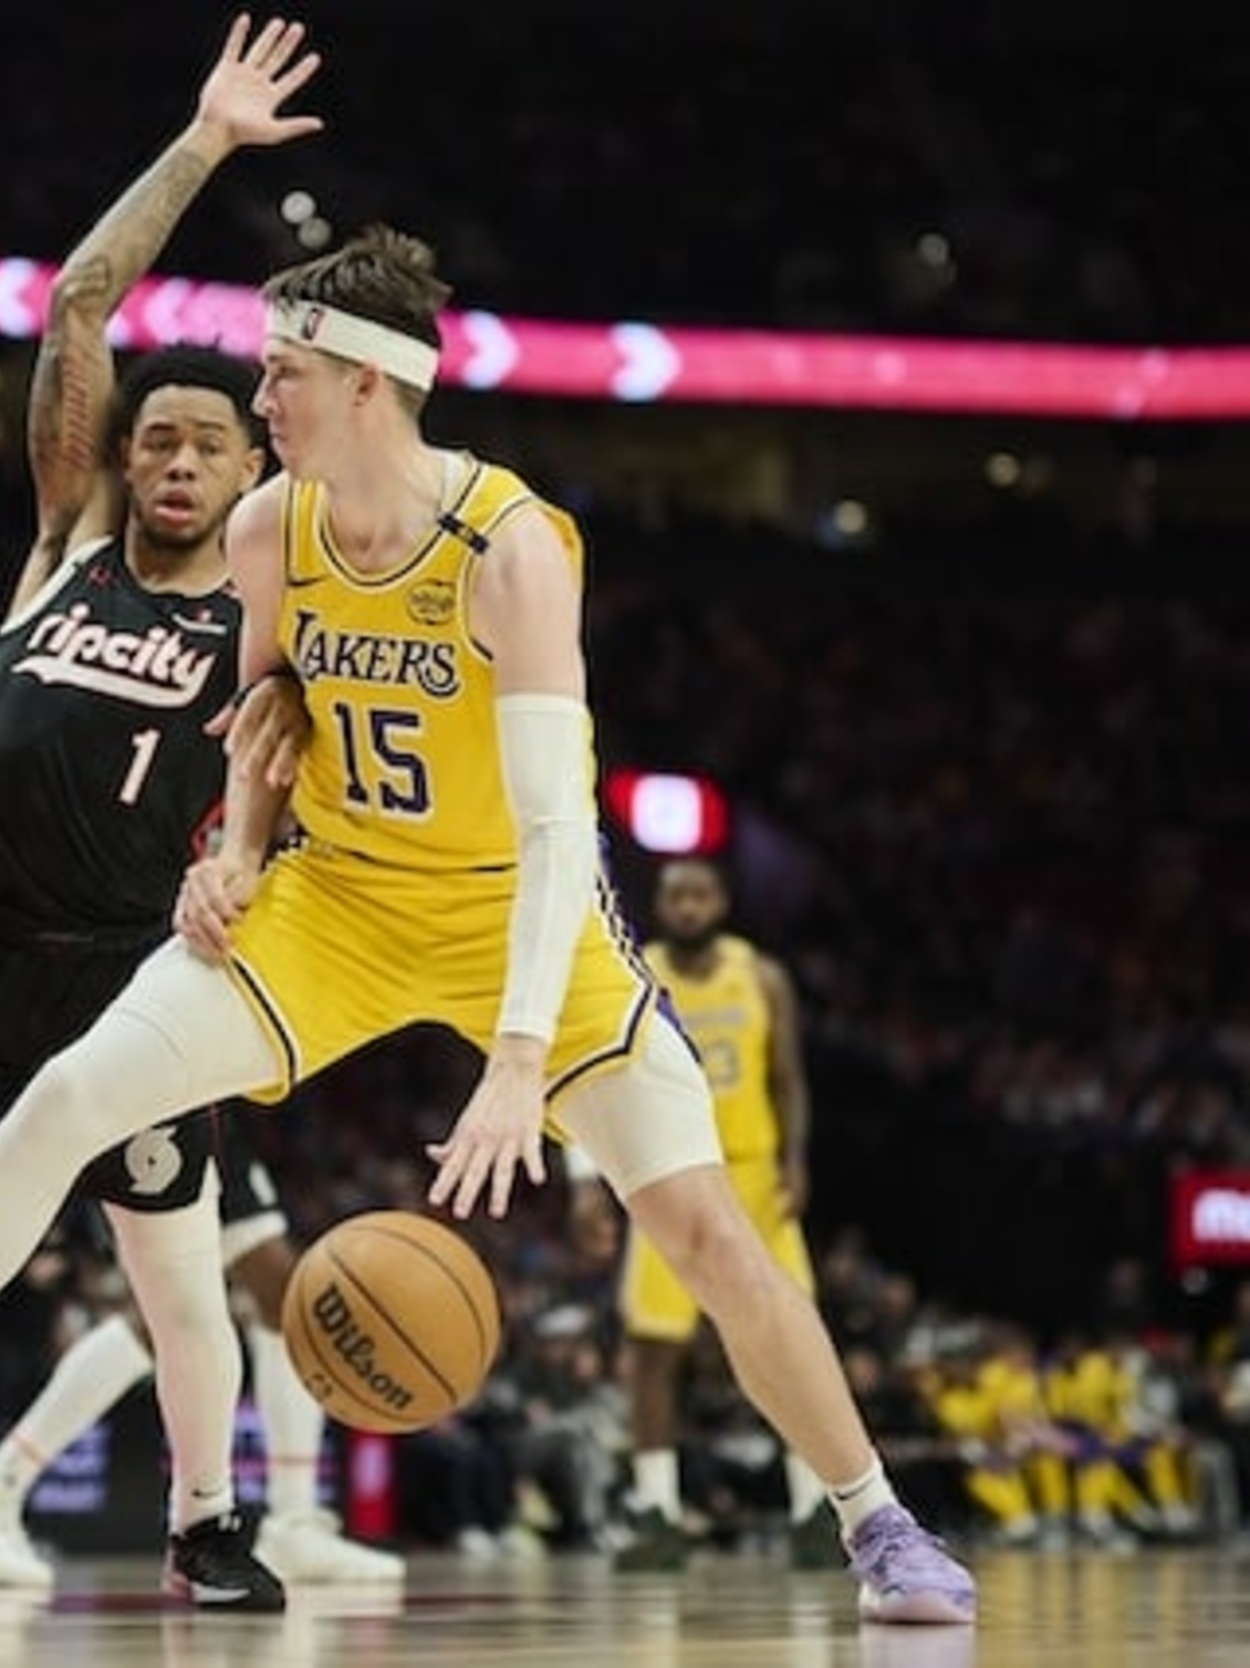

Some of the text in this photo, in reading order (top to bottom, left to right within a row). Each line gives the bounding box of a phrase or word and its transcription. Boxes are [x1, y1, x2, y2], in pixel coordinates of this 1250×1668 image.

[12, 603, 217, 708] ripcity
[294, 609, 462, 700] LAKERS
[119, 727, 161, 805] 1
[333, 701, 431, 815] 15
[313, 1281, 414, 1411] Wilson
